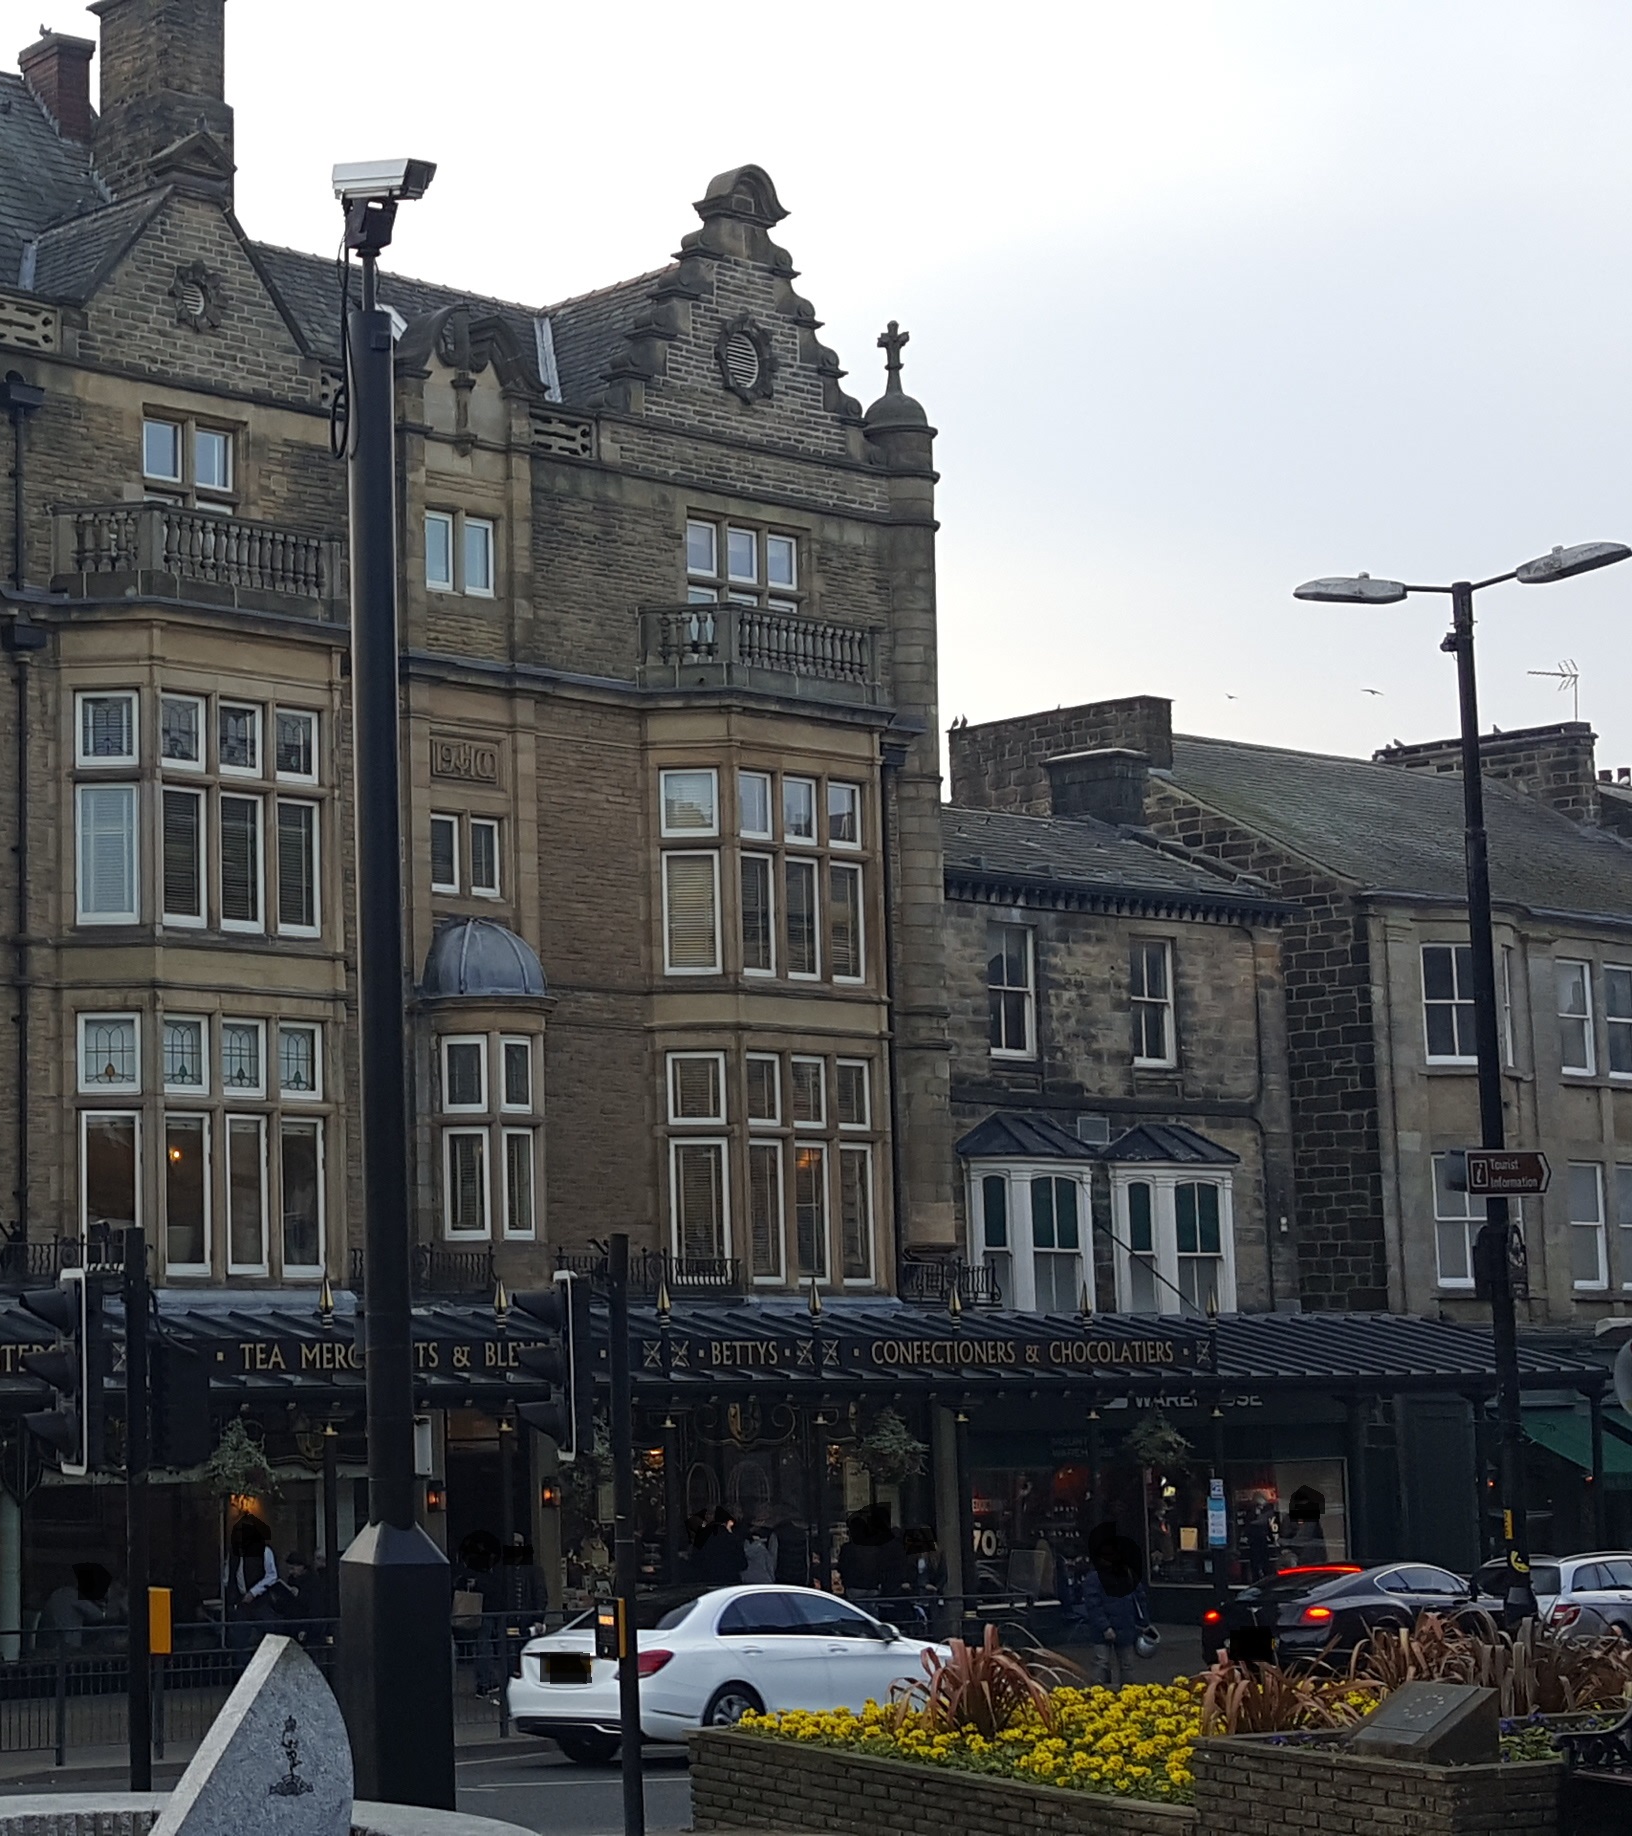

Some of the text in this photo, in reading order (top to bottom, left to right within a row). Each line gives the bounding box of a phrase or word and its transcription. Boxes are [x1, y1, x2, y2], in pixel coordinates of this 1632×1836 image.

[1490, 1159, 1519, 1170] Tourist
[1491, 1176, 1538, 1188] Information
[239, 1343, 287, 1370] TEA
[453, 1345, 472, 1368] &
[710, 1340, 779, 1365] BETTYS
[870, 1340, 1174, 1364] CONFECTIONERS & CHOCOLATIERS
